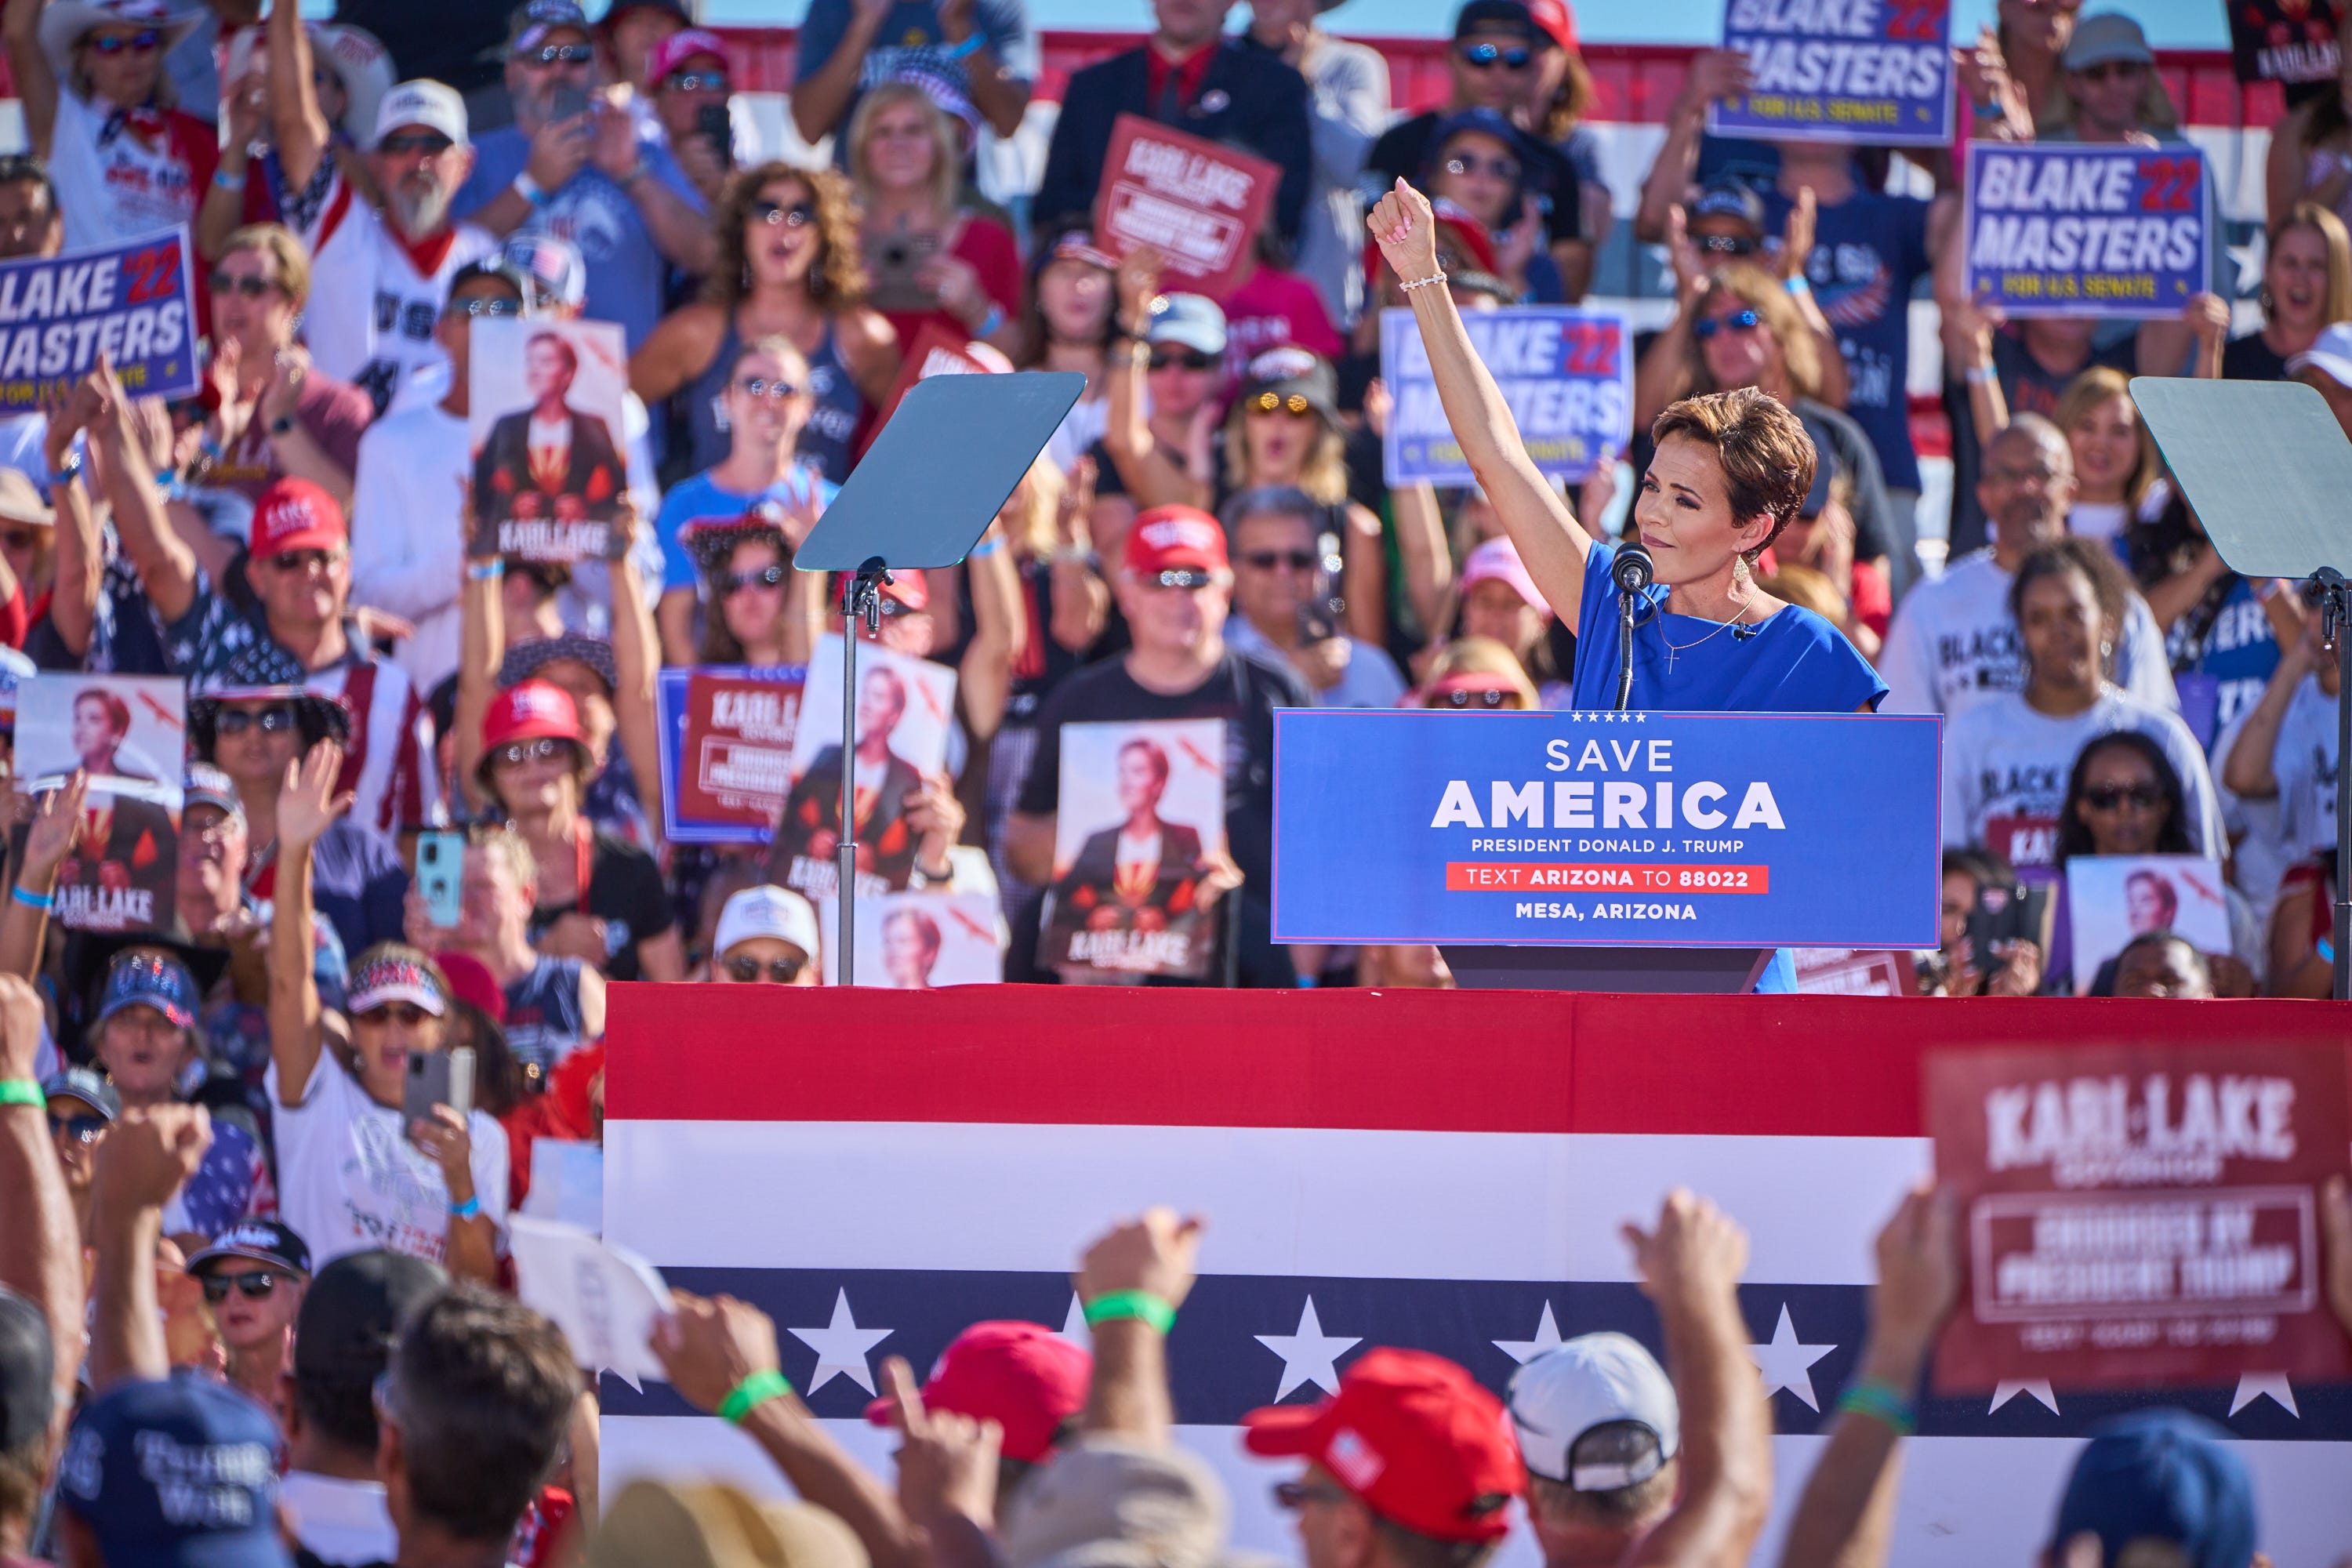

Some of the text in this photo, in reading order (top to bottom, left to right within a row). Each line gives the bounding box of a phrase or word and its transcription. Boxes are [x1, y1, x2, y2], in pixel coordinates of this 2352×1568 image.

[1727, 0, 1878, 36] BLAKE
[1976, 155, 2136, 212] BLAKE
[1972, 214, 2201, 272] MASTERS
[0, 254, 121, 325] LAKE
[1545, 739, 1673, 772] SAVE
[1430, 781, 1786, 829] AMERICA
[1472, 838, 1744, 853] PRESIDENT DONALD J. TRUMP
[1466, 869, 1748, 887] TEXT ARIZONA TO 88022
[1515, 902, 1697, 922] MESA, ARIZONA
[2145, 1072, 2296, 1162] LAKE
